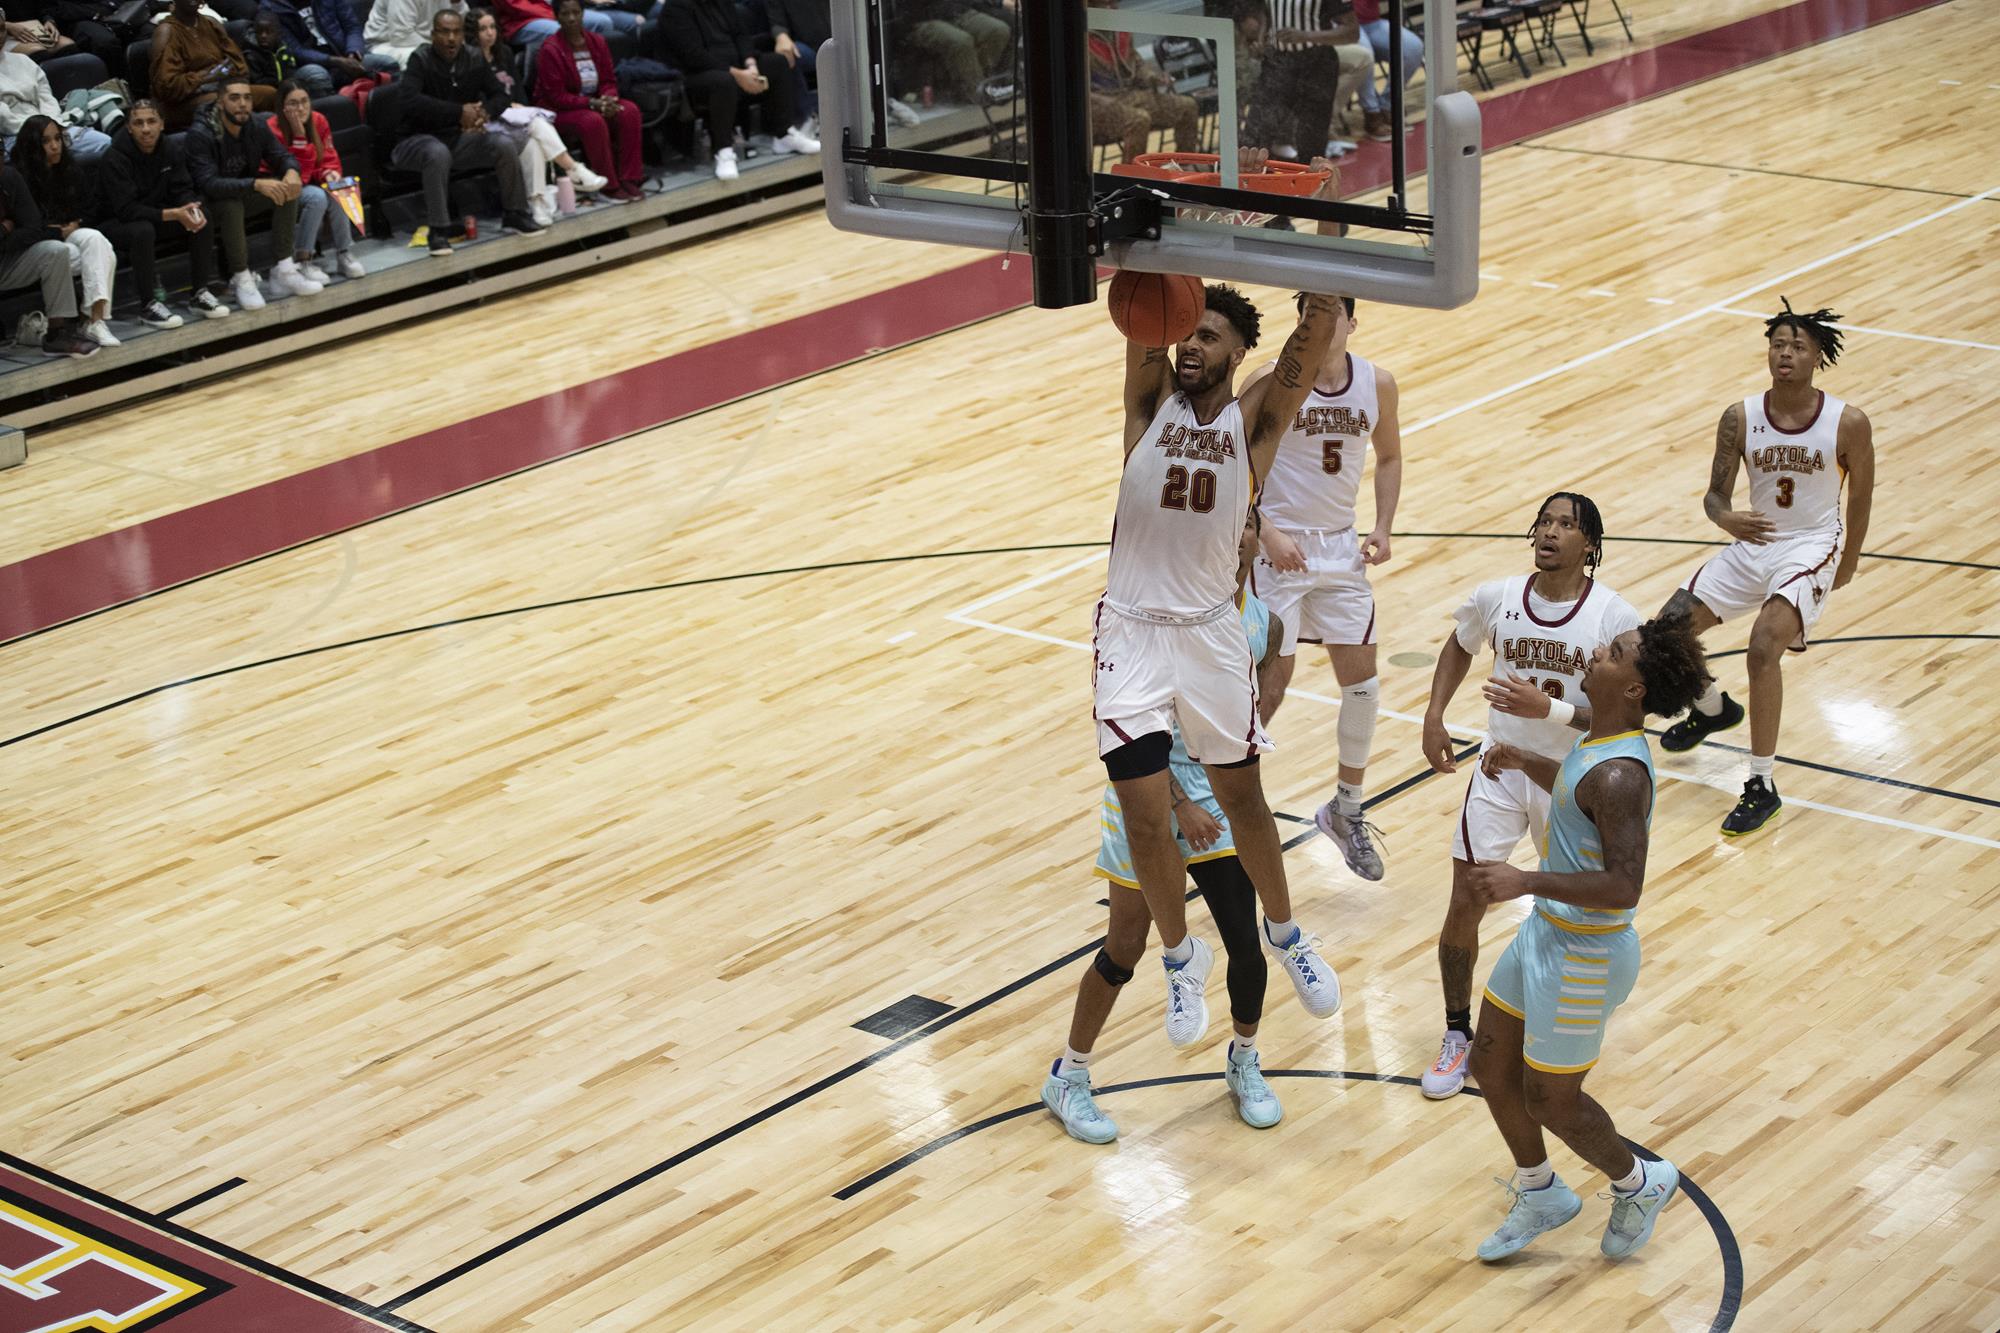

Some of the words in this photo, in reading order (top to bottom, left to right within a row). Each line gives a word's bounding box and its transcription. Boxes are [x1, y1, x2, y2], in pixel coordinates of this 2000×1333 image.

[1293, 407, 1369, 432] LOYOLA
[1155, 422, 1237, 459] LOYOLA
[1165, 448, 1183, 458] NEW
[1184, 448, 1224, 465] ORLEANS
[1322, 440, 1343, 474] 5
[1752, 445, 1825, 471] LOYOLA
[1160, 464, 1217, 513] 20
[1776, 476, 1795, 509] 3
[1503, 638, 1586, 671] LOYOLA
[1515, 660, 1533, 669] NEW
[1535, 660, 1574, 676] ORLEANS
